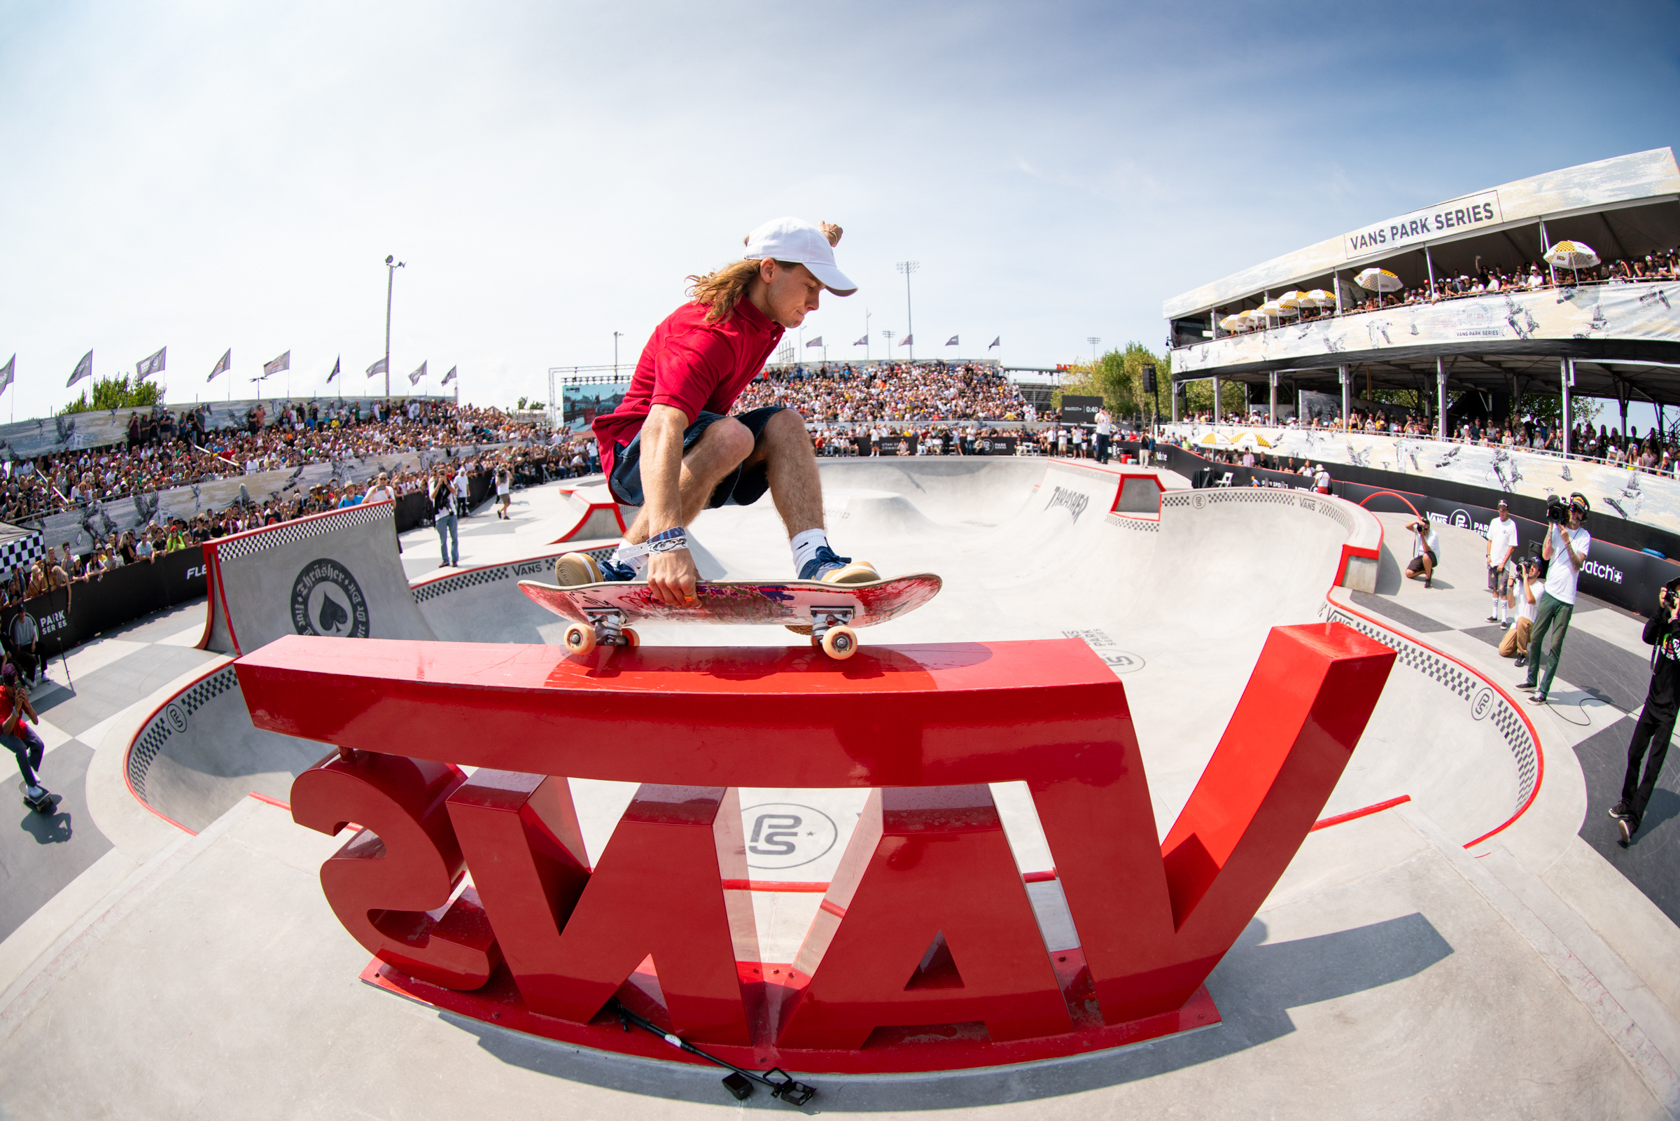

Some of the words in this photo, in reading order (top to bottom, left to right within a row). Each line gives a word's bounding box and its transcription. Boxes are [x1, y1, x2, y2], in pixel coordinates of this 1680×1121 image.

[1350, 229, 1387, 250] VANS
[1390, 217, 1431, 241] PARK
[1434, 202, 1494, 230] SERIES
[1085, 405, 1099, 413] 0:40
[1043, 486, 1089, 525] THRASHER
[1300, 496, 1316, 511] VANS
[1473, 521, 1491, 532] PAR
[511, 561, 542, 576] VANS
[1580, 560, 1615, 581] atch
[39, 609, 66, 628] PARK
[41, 619, 68, 636] SERES
[1080, 629, 1107, 647] PARK
